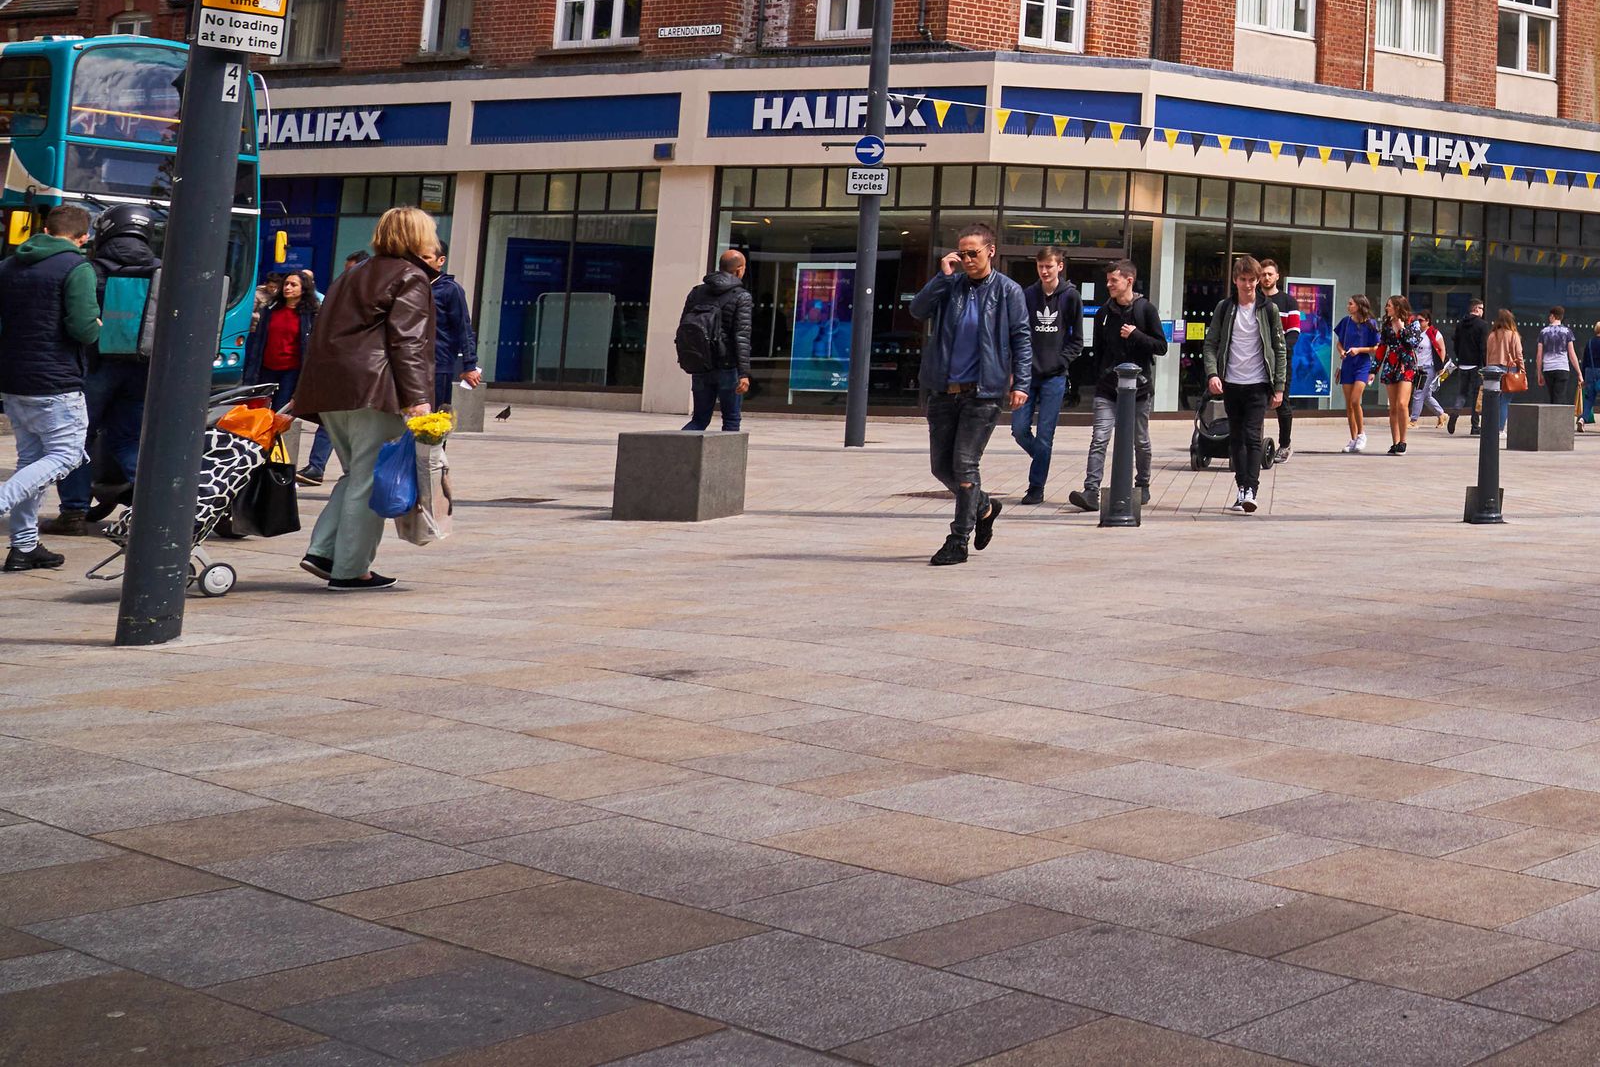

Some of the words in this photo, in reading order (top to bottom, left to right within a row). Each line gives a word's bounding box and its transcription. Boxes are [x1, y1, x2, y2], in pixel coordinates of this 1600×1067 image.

[205, 14, 224, 26] No
[229, 16, 278, 35] loading
[660, 28, 700, 36] CLARENDON
[702, 26, 720, 34] ROAD
[201, 31, 216, 42] at
[220, 34, 244, 47] any
[248, 35, 278, 50] time
[258, 110, 384, 144] HALIFAX
[1367, 128, 1490, 170] HALIFAX
[852, 172, 884, 182] Except
[852, 182, 882, 191] cycles
[1034, 324, 1059, 332] adidas
